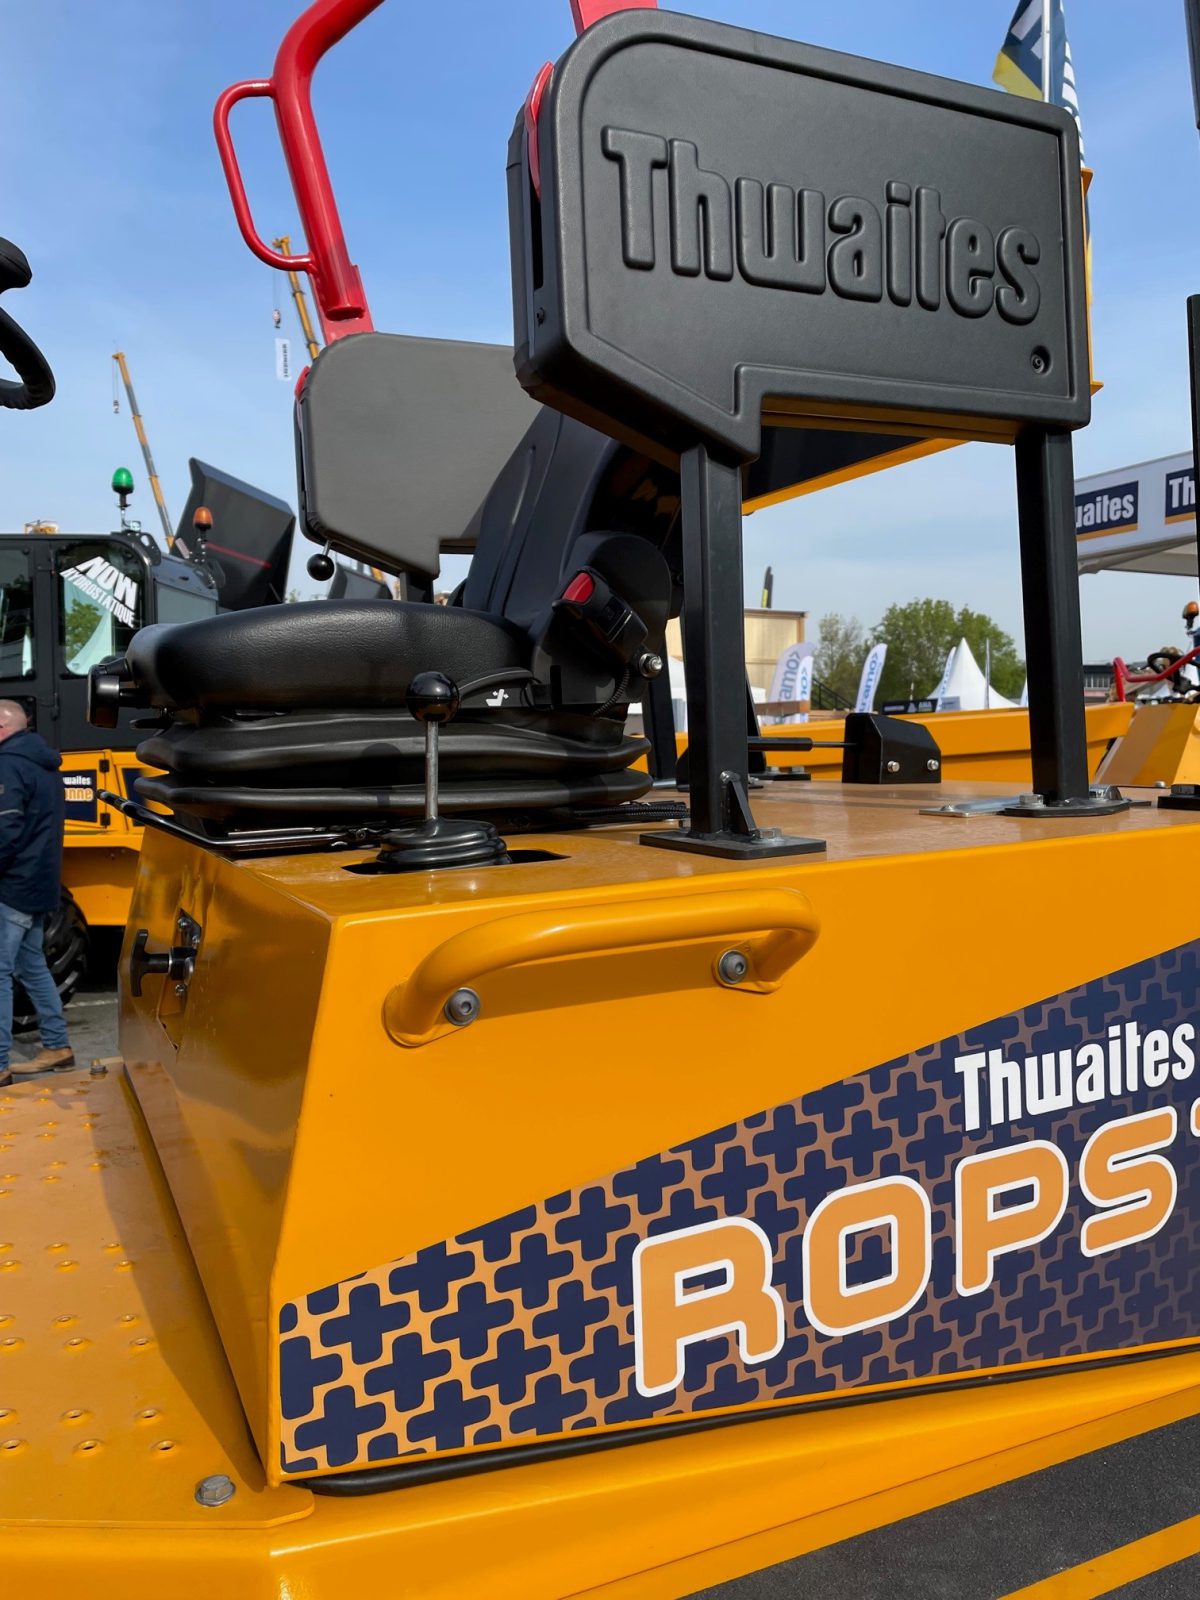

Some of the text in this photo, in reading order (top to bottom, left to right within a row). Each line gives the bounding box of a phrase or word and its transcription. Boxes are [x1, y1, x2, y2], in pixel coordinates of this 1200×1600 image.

[600, 125, 1041, 326] Thwaites
[1075, 494, 1135, 528] aites
[75, 556, 138, 611] NOW
[63, 775, 92, 785] waites
[64, 787, 93, 801] nne
[954, 1021, 1196, 1131] Thwaites
[632, 1097, 1200, 1398] ROPS
